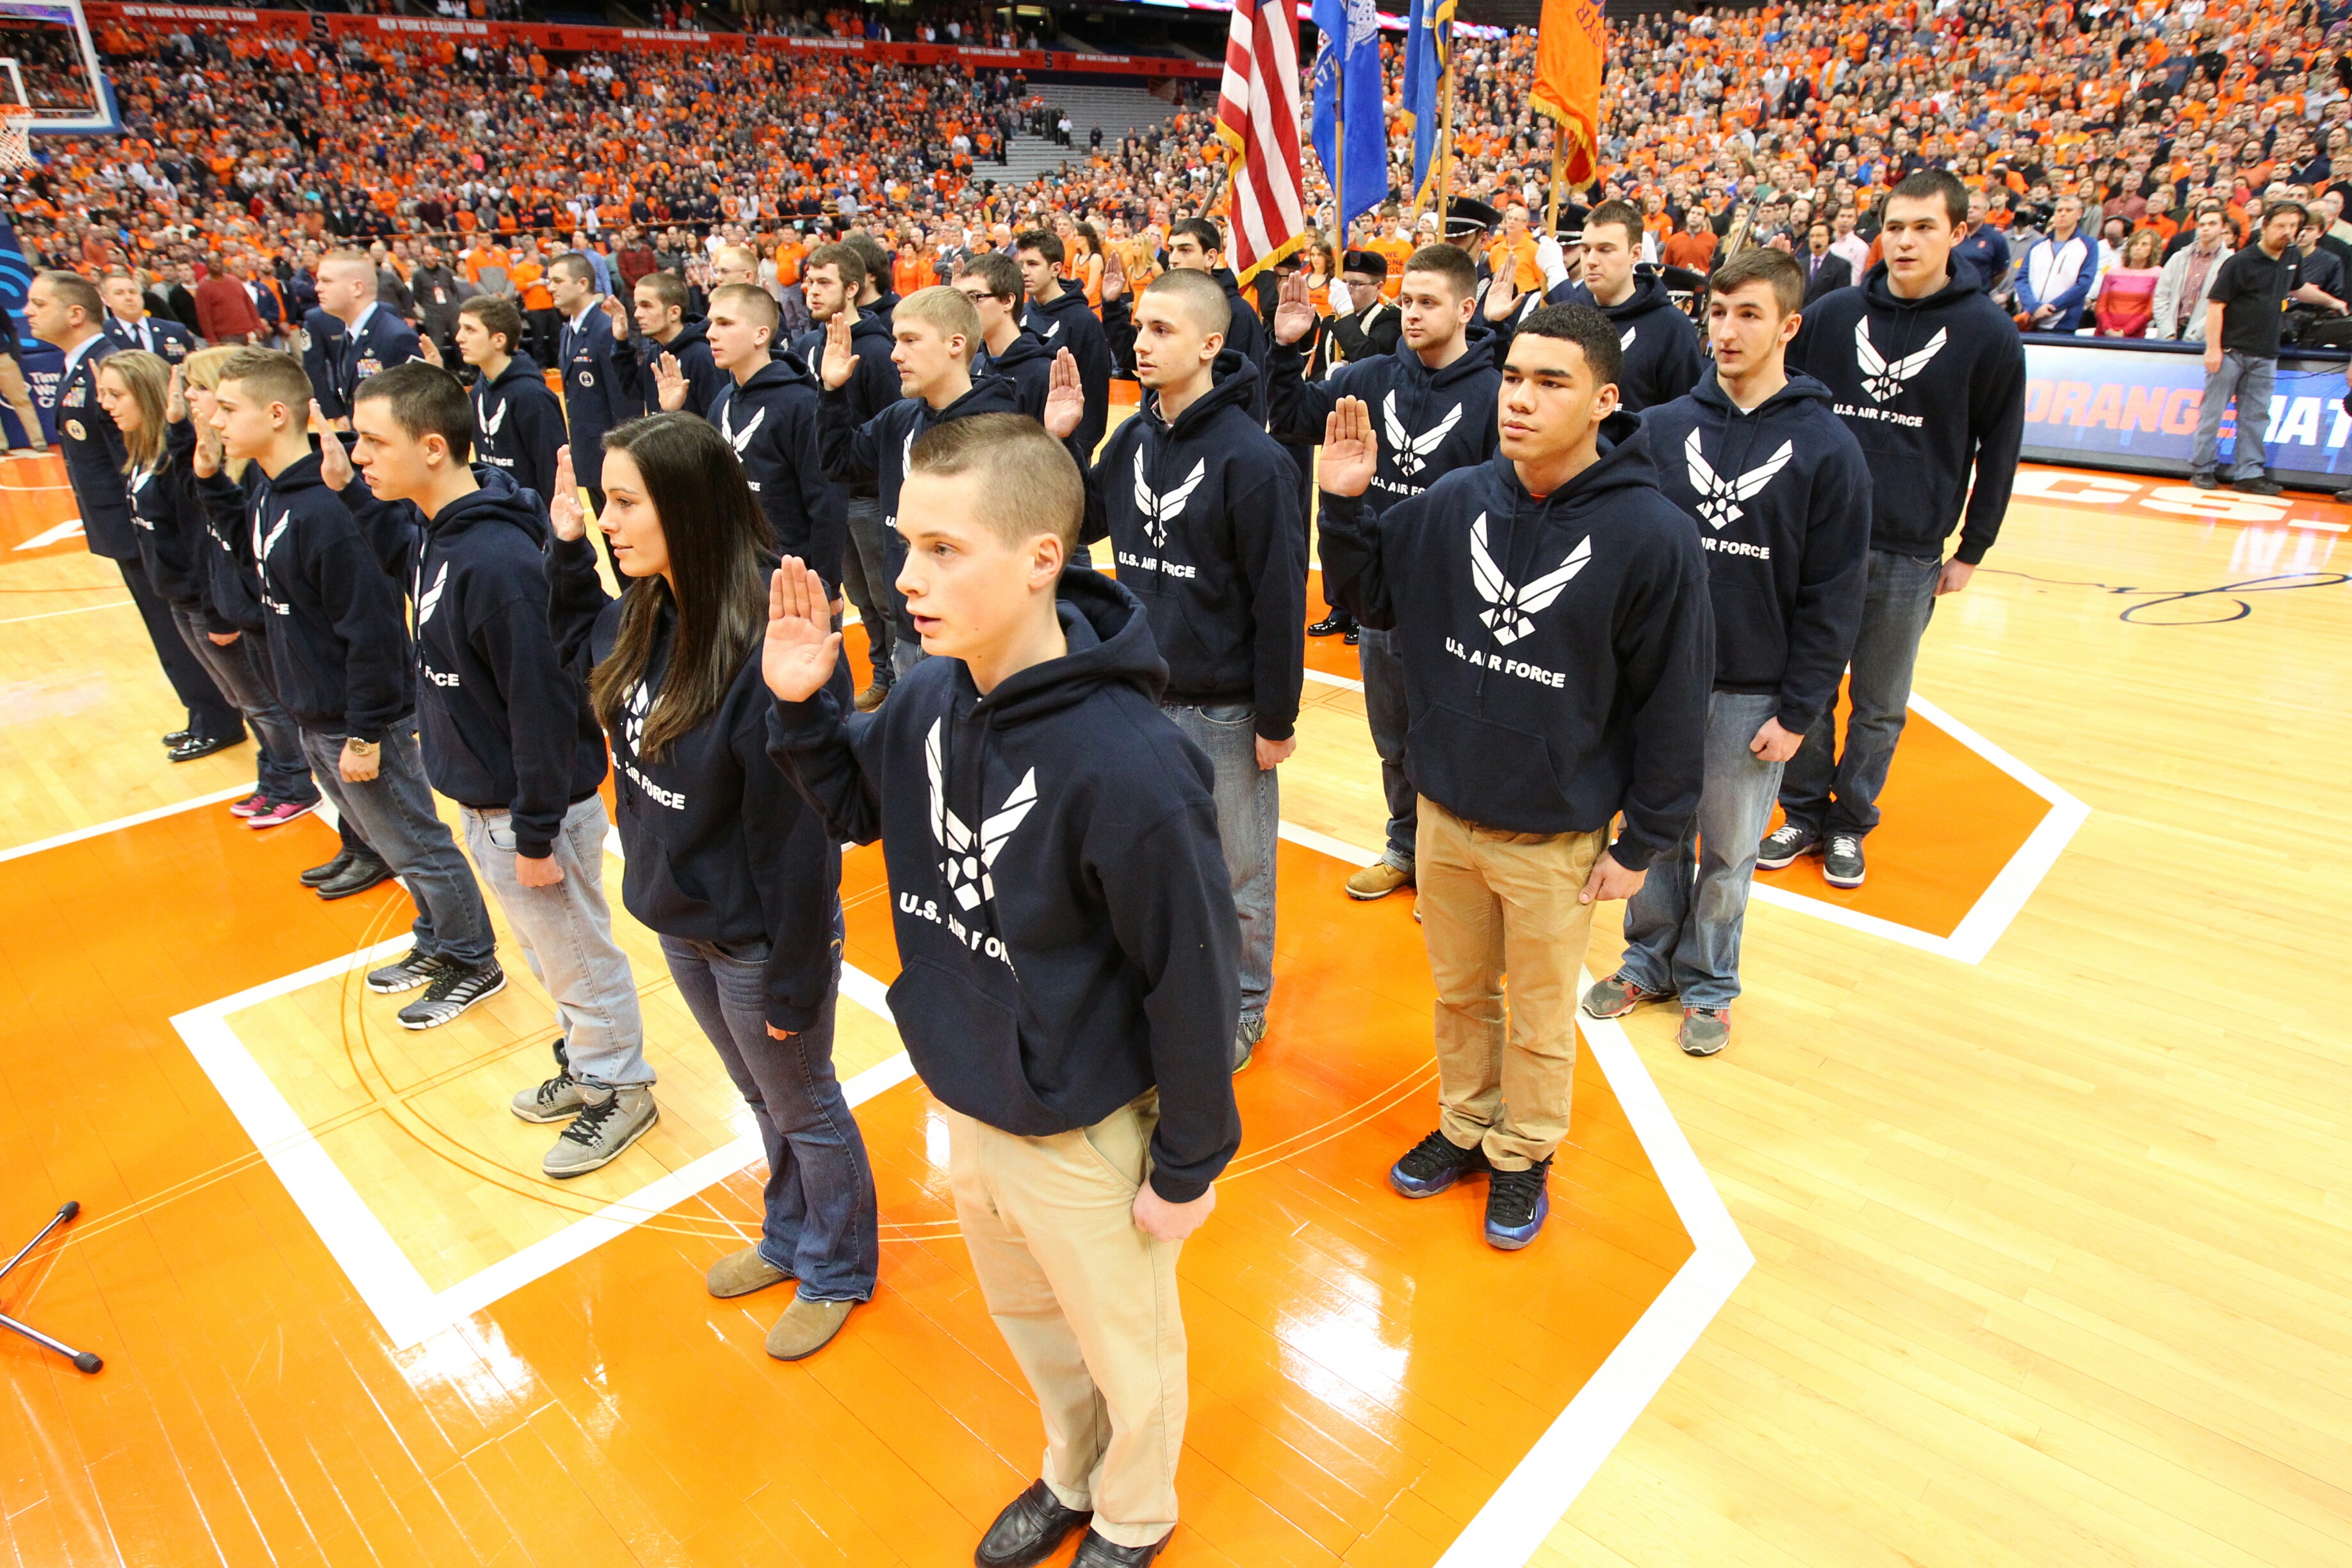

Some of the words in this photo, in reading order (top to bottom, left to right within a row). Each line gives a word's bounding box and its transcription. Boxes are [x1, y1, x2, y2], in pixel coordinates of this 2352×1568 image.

[122, 6, 147, 17] NEW
[147, 6, 186, 18] YORK'S
[185, 8, 231, 20] COLLEGE
[229, 10, 257, 22] TEAM
[1833, 404, 1856, 416] U.S.
[1858, 407, 1879, 420] AIR
[1880, 410, 1923, 427] FORCE
[1371, 476, 1386, 490] U.S.
[1387, 482, 1409, 495] AIR
[1701, 537, 1717, 551] IR
[1719, 540, 1770, 560] FORCE
[1118, 551, 1139, 568] U.S.
[1141, 556, 1157, 571] AIR
[1445, 637, 1466, 660] U.S.
[1505, 659, 1566, 689] FORCE
[641, 774, 686, 810] FORCE
[899, 892, 942, 924] U.S.
